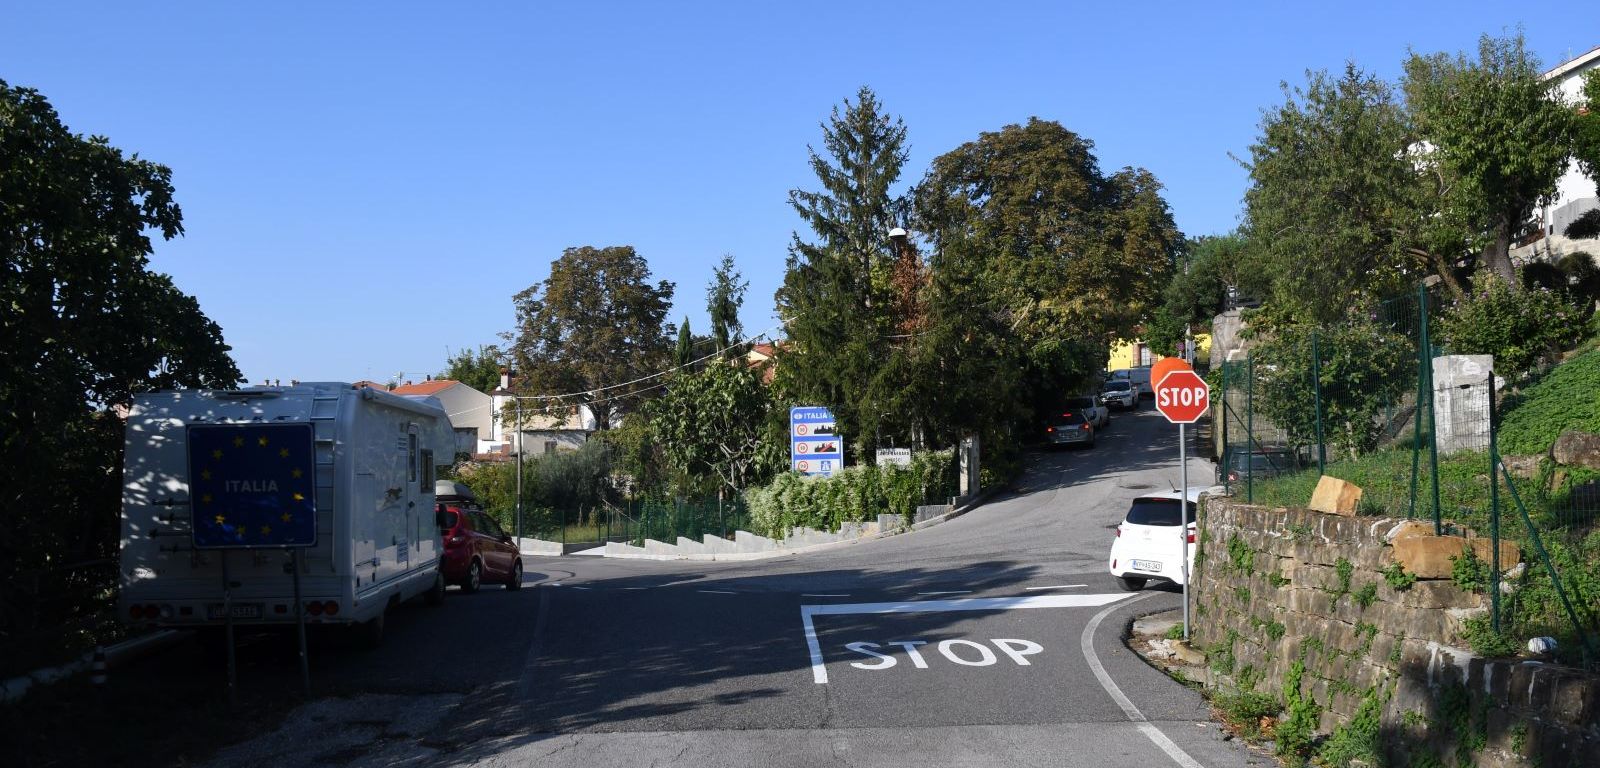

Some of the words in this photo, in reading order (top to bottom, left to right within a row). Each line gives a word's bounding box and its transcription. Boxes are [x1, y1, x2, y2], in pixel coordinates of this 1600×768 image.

[1159, 387, 1206, 407] STOP
[224, 479, 280, 493] ITALIA
[845, 638, 1044, 670] STOP
